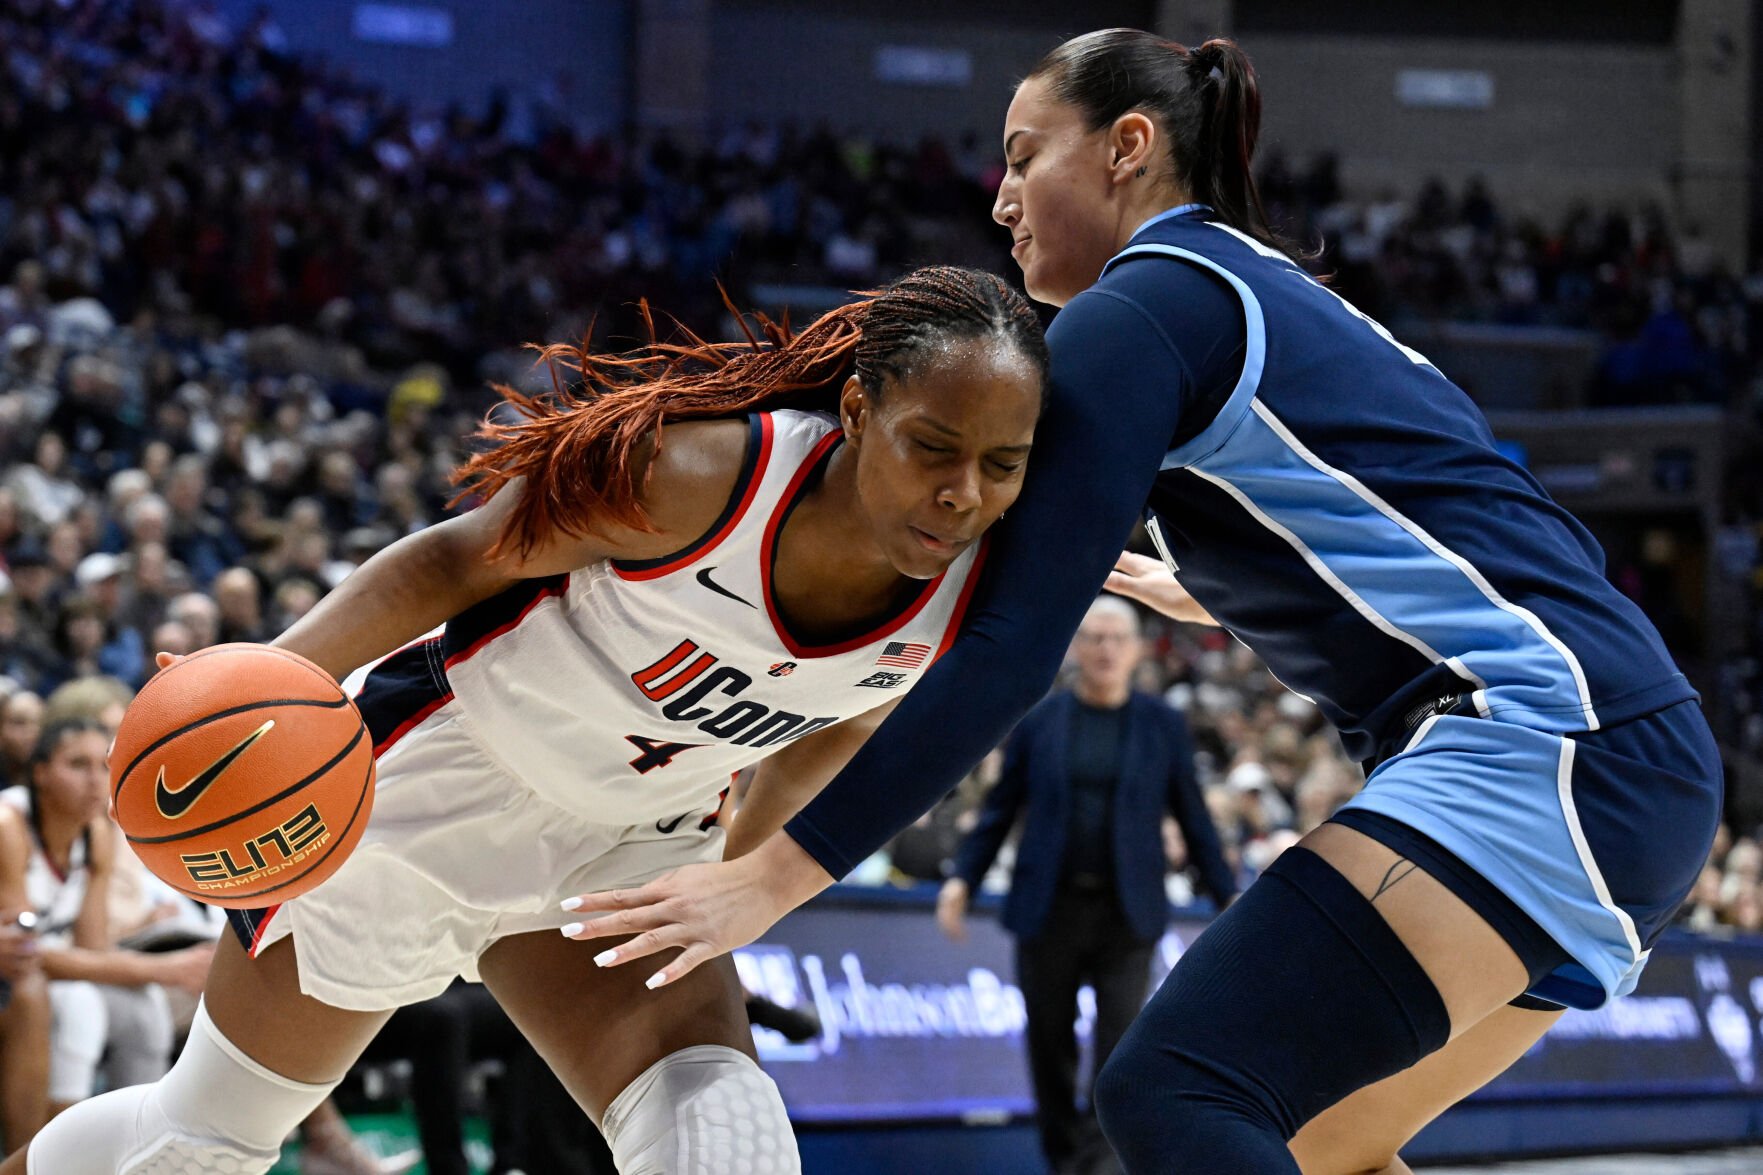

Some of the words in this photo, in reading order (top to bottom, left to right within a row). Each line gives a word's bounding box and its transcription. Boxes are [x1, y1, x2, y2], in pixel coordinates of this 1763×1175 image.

[870, 671, 907, 680] BIG
[1438, 694, 1454, 708] XL
[624, 734, 716, 774] 4
[180, 802, 328, 883] ELITE
[197, 834, 331, 889] CHAMPIONSHIP
